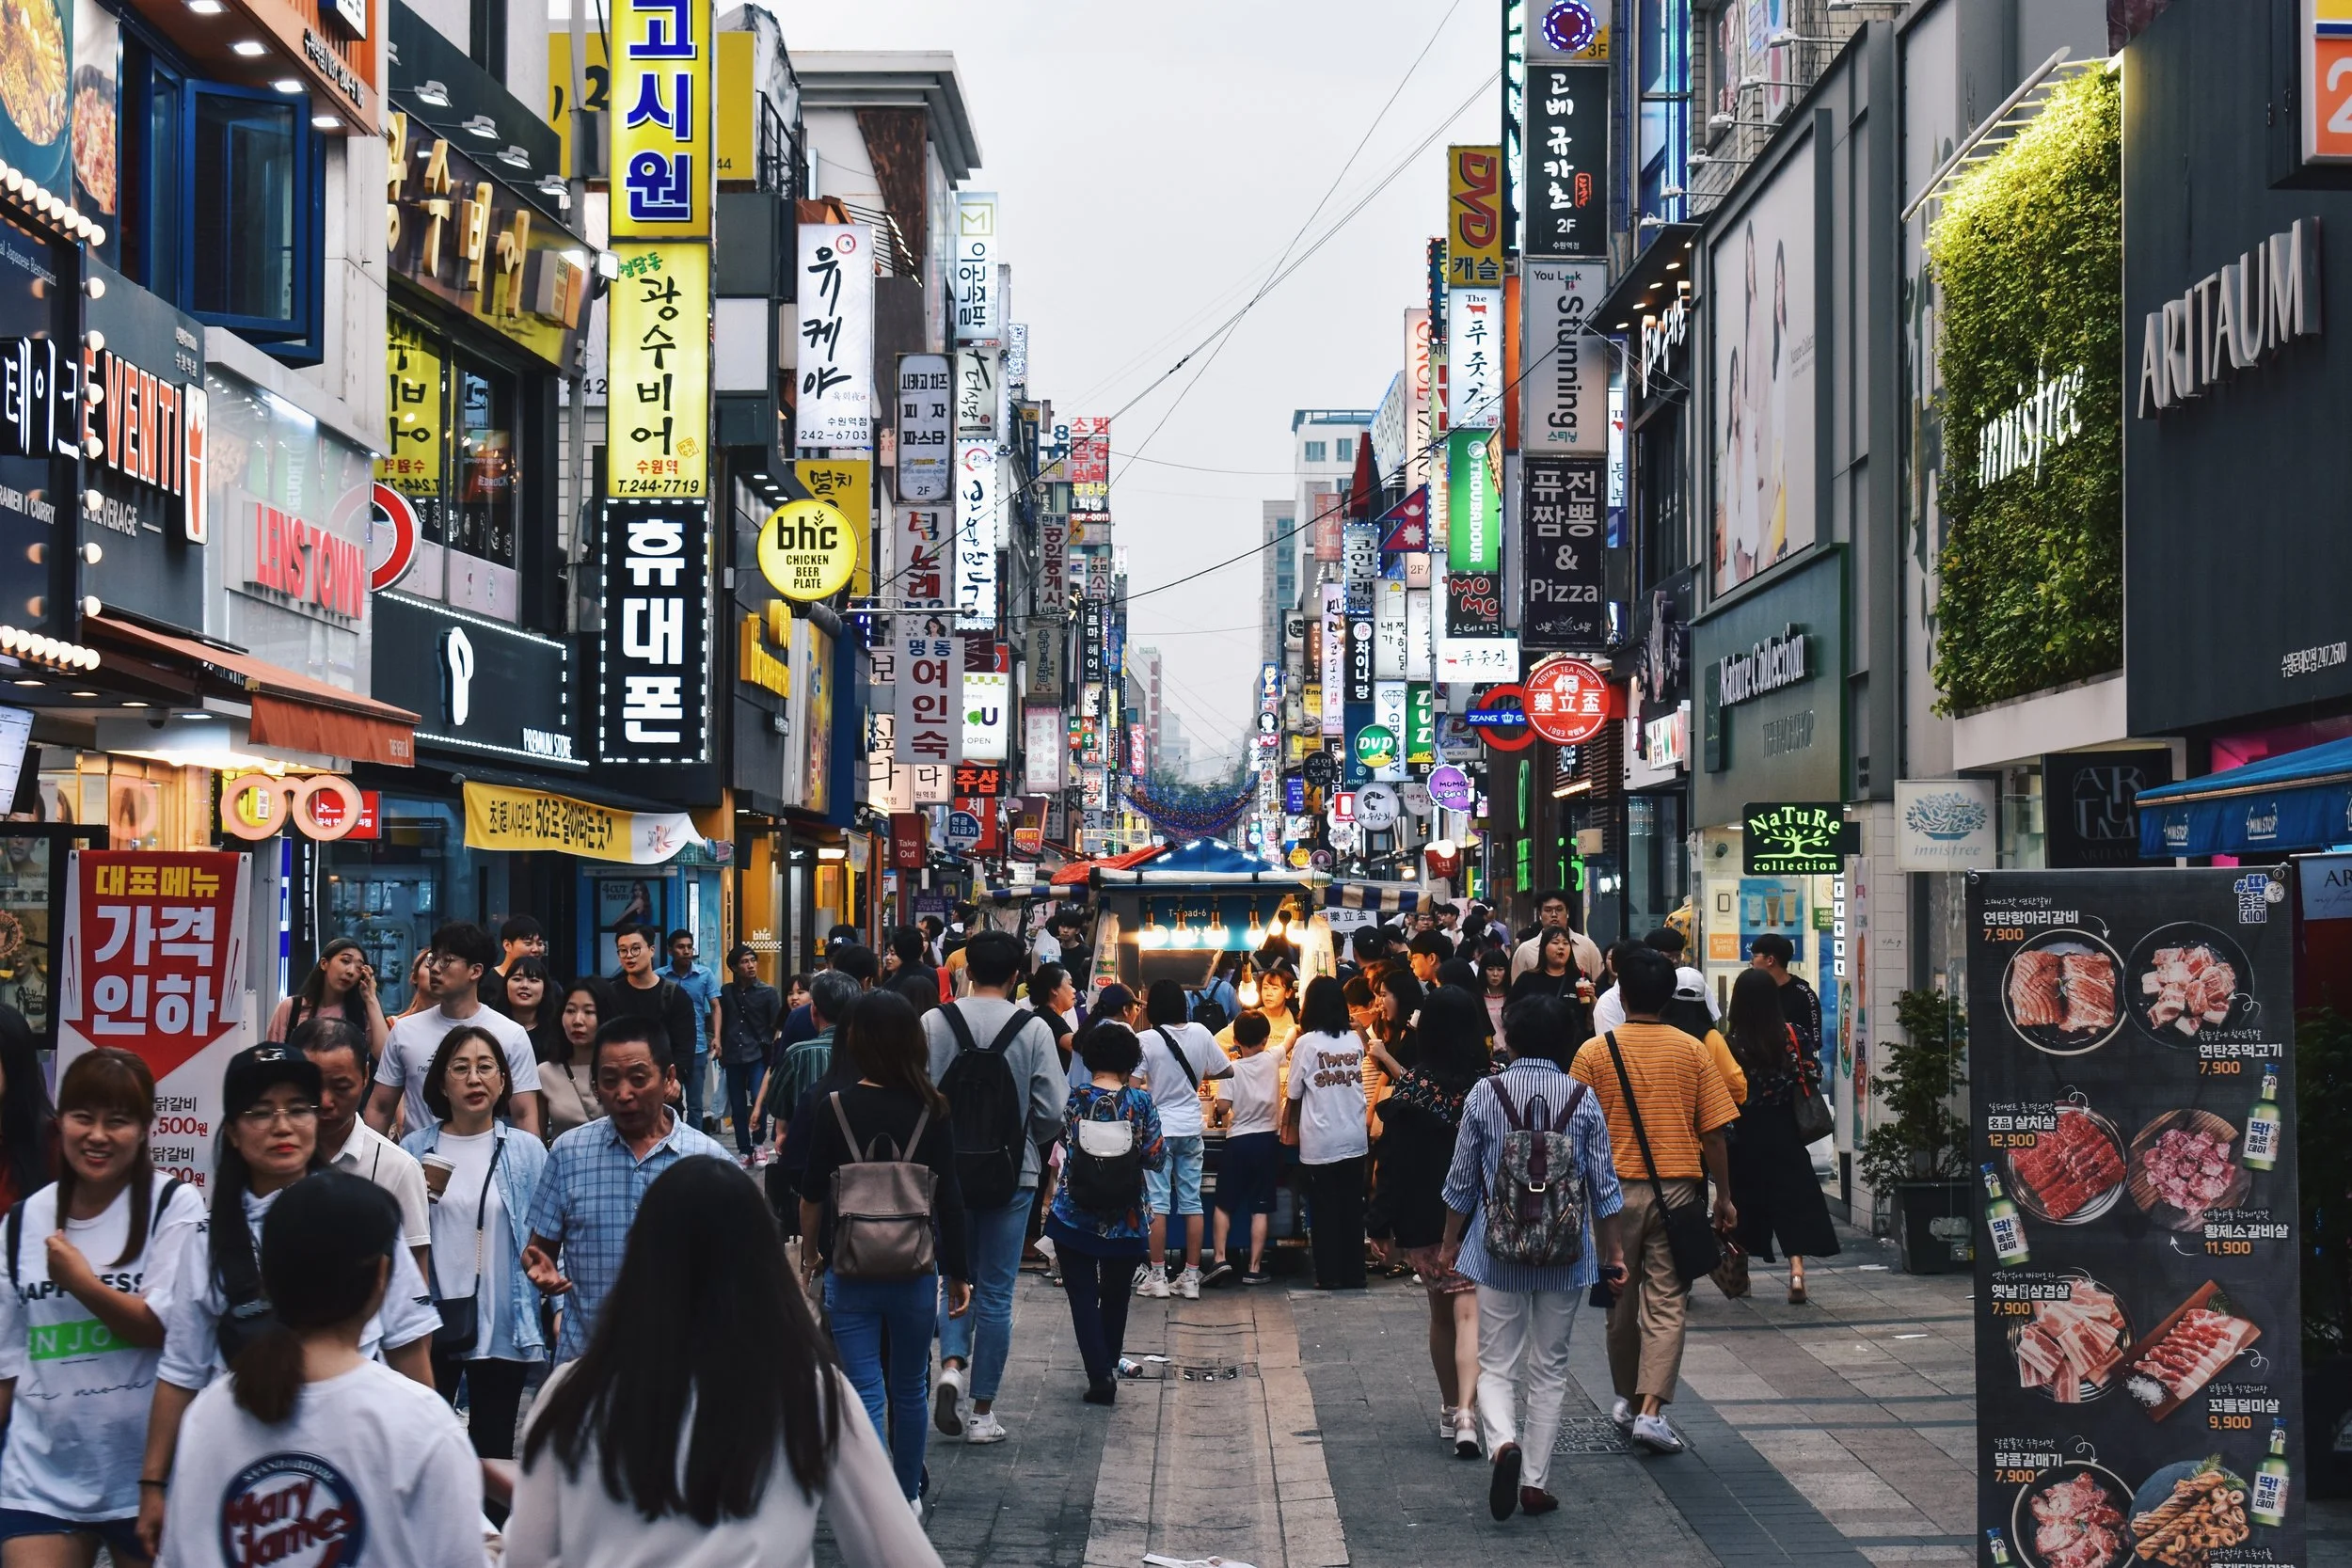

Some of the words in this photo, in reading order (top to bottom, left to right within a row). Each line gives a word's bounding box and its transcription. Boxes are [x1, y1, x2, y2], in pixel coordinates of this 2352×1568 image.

[1588, 43, 1607, 56] 3F
[1546, 73, 1574, 116] 고베
[626, 0, 697, 221] 고시원
[1543, 126, 1575, 210] 규카츠
[1454, 152, 1497, 248] DVD
[1557, 218, 1577, 233] 2F
[1552, 241, 1580, 249] 수원역점
[7, 243, 29, 265] Japanese
[619, 251, 662, 278] 청담동
[1454, 256, 1499, 280] 캐슬
[1534, 270, 1553, 281] You
[960, 243, 986, 328] 이공족발
[1465, 294, 1487, 303] The
[803, 246, 852, 399] 유케야
[2137, 217, 2304, 420] ARITAUM
[630, 276, 682, 455] 광수비어
[1548, 295, 1584, 429] Stunning
[901, 373, 928, 390] 시카고
[930, 373, 947, 390] 치즈
[105, 350, 183, 496] VENTI
[828, 417, 867, 427] 수원역점
[1979, 343, 2084, 489] innisfree
[801, 430, 868, 440] 242-6703
[903, 431, 946, 445] 파스타
[1548, 431, 1578, 443] 스터닝
[637, 460, 678, 475] 수원역
[617, 479, 699, 494] T.244-7719
[810, 469, 852, 495] 멸치
[1532, 470, 1596, 502] 퓨전
[917, 486, 930, 496] 2F
[31, 498, 56, 525] CURRY
[1470, 461, 1484, 563] TROUBADOUR
[1532, 504, 1597, 537] 짬뽕
[777, 516, 837, 549] bhc
[257, 501, 305, 600] LENS
[309, 526, 364, 620] TOWN
[786, 555, 829, 565] CHICKEN
[1555, 545, 1579, 571] &
[796, 566, 819, 577] BEER
[1044, 528, 1066, 607] 공인중개사
[1349, 539, 1375, 595] 코인노래
[794, 578, 822, 590] PLATE
[1530, 578, 1598, 603] Pizza
[623, 518, 685, 743] 휴대폰
[1381, 622, 1393, 644] 내가
[1454, 624, 1499, 634] 스테이크
[909, 640, 951, 657] 명동
[1460, 650, 1508, 668] 푸줏간
[1720, 652, 1751, 706] Nature
[1752, 623, 1804, 695] Collection
[1355, 641, 1370, 699] 차이나당
[1536, 669, 1559, 685] ROYAL
[1576, 669, 1597, 685] HOUSE
[911, 659, 949, 760] 여인숙
[1534, 692, 1600, 712] 樂立盃
[1548, 725, 1565, 736] 1993
[523, 727, 553, 755] PREMIUM
[554, 735, 571, 759] STORE
[1259, 736, 1278, 745] PC
[1359, 736, 1392, 750] DVD
[951, 816, 967, 825] 현금
[2249, 816, 2277, 834] MINISTOP
[951, 826, 976, 835] 지급기
[898, 839, 917, 848] Take
[1914, 844, 1981, 857] innisfree
[900, 850, 915, 859] Out
[1754, 860, 1836, 871] collection
[95, 865, 220, 897] 대표메뉴
[2019, 896, 2052, 908] 연탄갈비
[1983, 911, 2078, 925] 연탄항아리갈비
[95, 905, 216, 967] 가격
[754, 930, 771, 941] bhc
[1983, 927, 2024, 942] 7,900
[93, 973, 215, 1037] 인하
[2199, 1043, 2282, 1058] 연탄주먹고기
[2199, 1061, 2241, 1075] 7,900
[2014, 1116, 2057, 1130] 살치살
[1988, 1133, 2035, 1148] 12,900
[2248, 1143, 2267, 1154] 데이
[2204, 1224, 2289, 1239] 황제소갈비살
[2204, 1242, 2251, 1255] 11,900
[1992, 1284, 2018, 1299] 옛날
[2029, 1284, 2070, 1299] 삼겹살
[1992, 1302, 2030, 1316] 7,900
[2209, 1398, 2280, 1413] 꼬들덜미살
[2209, 1416, 2251, 1430] 9,900
[1994, 1452, 2062, 1467] 달콤갈매기
[1994, 1469, 2034, 1483] 7,900
[225, 1477, 316, 1526] Mary
